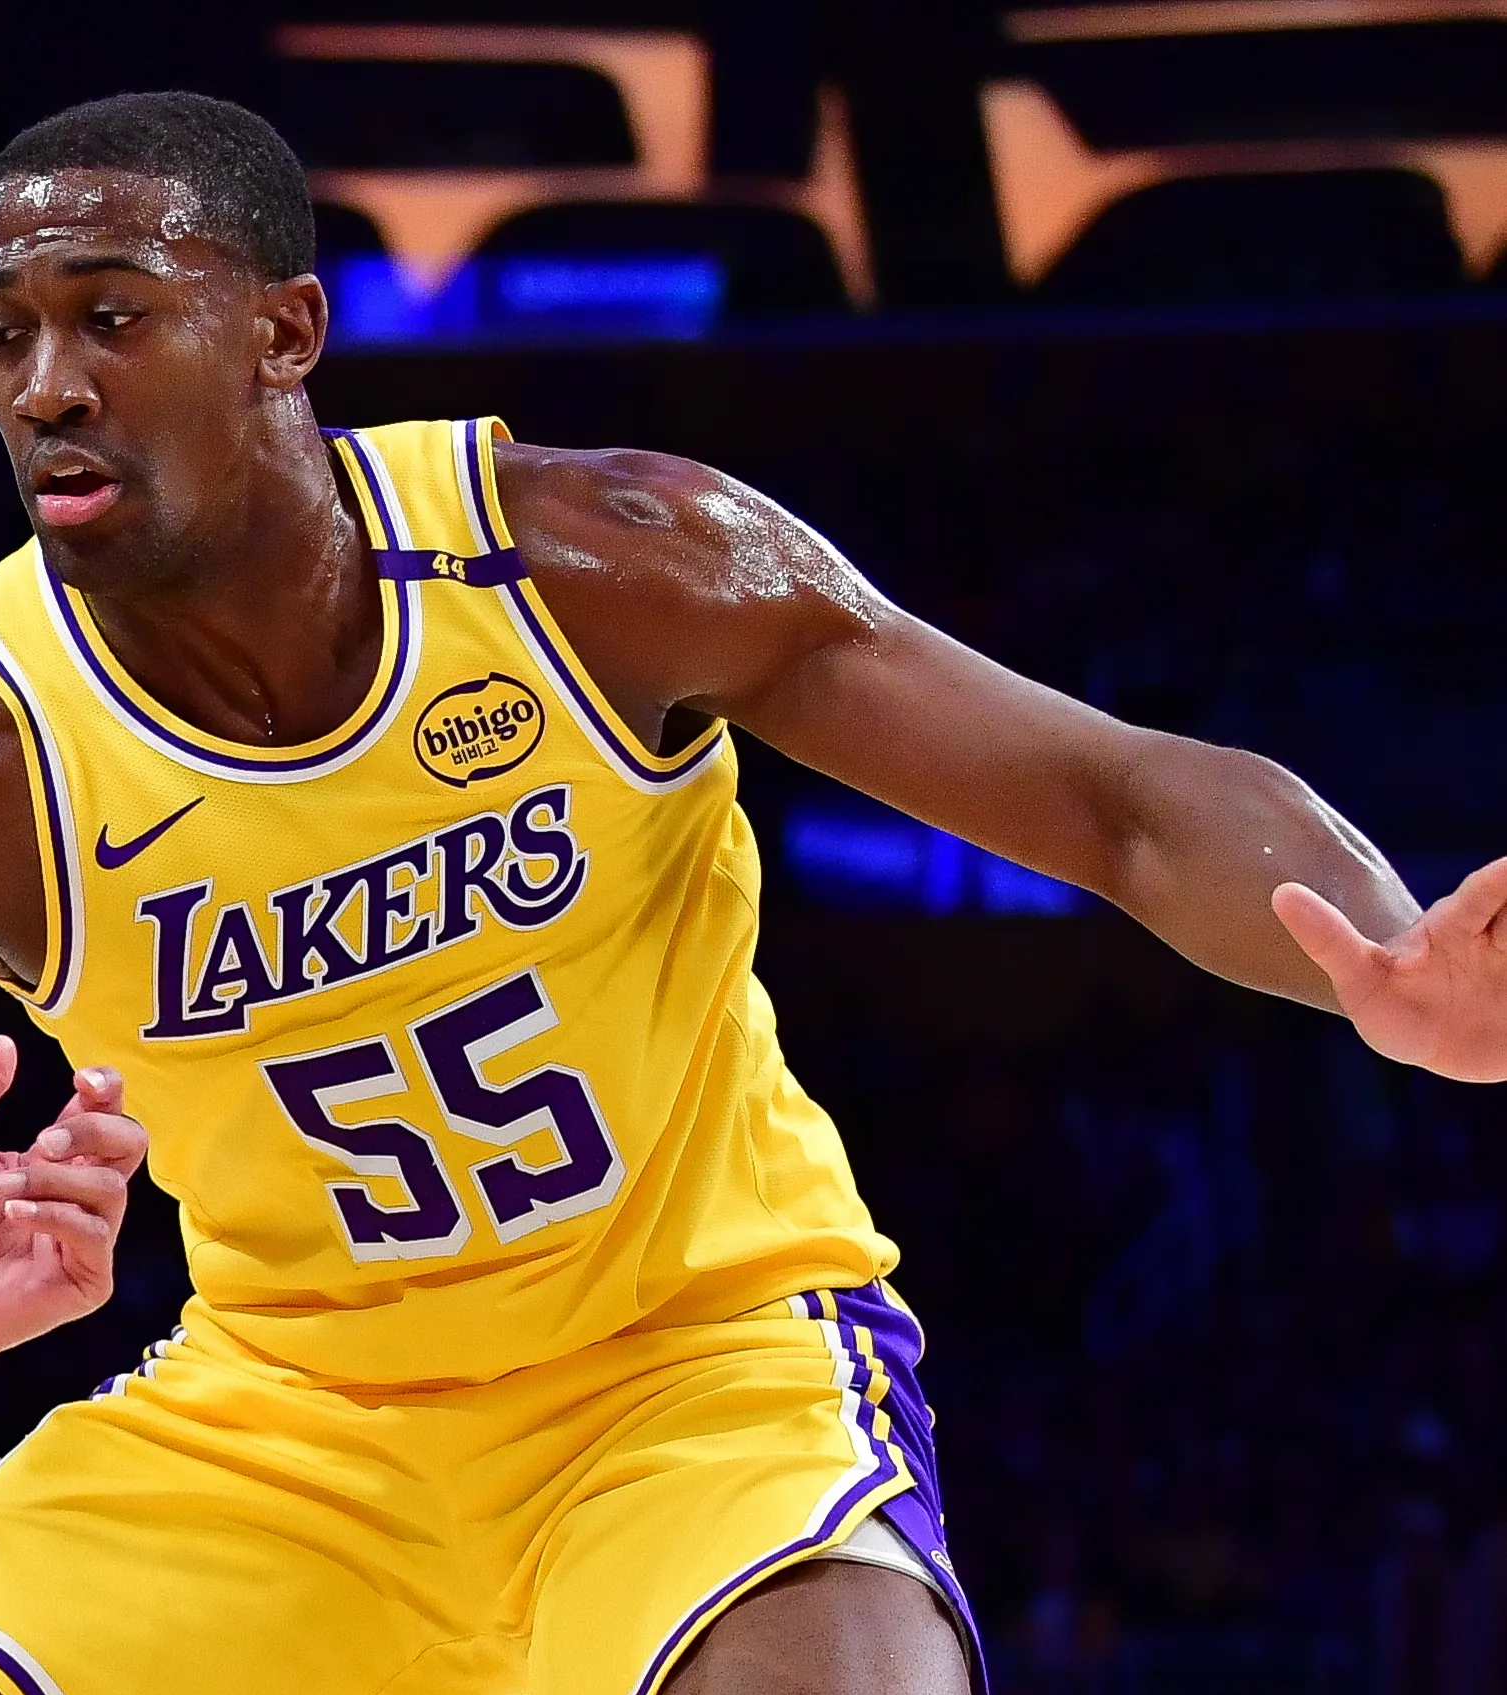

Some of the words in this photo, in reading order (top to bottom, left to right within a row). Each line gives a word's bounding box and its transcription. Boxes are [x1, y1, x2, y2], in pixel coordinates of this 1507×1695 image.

[432, 553, 466, 580] 44
[422, 700, 534, 757] bibigo
[450, 737, 500, 766] 비비고
[135, 783, 589, 1042] LAKERS
[255, 964, 627, 1264] 55
